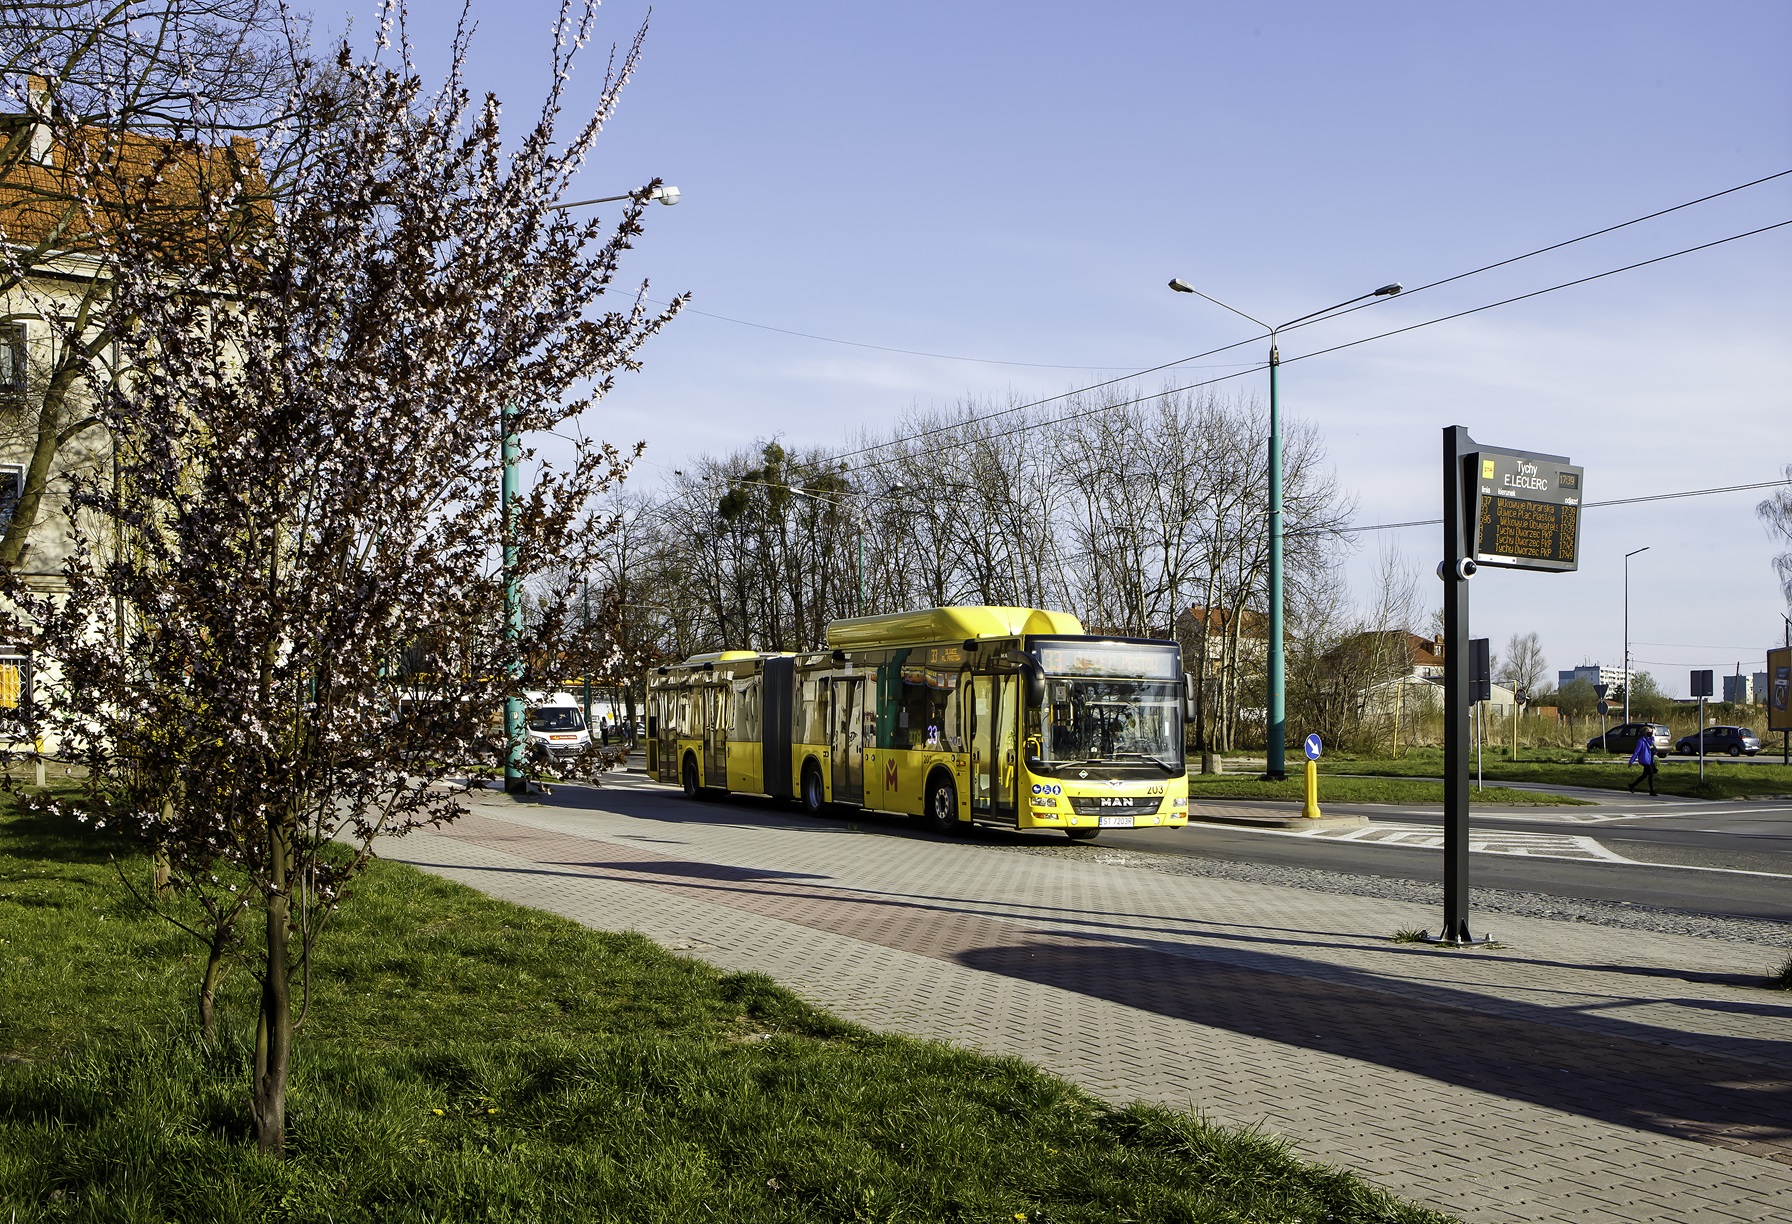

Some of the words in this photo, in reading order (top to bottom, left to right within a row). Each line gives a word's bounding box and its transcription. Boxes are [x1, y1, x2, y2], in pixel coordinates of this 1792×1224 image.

[1517, 461, 1538, 477] Tychy
[1504, 474, 1548, 491] E.LECLERC
[1518, 510, 1531, 519] Plac
[1496, 524, 1515, 535] Tychy
[1515, 527, 1541, 538] Dworzec
[1541, 530, 1553, 540] PKP
[1495, 533, 1514, 544] Tychy
[1514, 536, 1540, 547] Dworzec
[1541, 539, 1553, 549] PKP
[1495, 542, 1514, 553] Tychy
[1514, 545, 1540, 556] Dworzec
[1540, 547, 1552, 558] PKP
[930, 648, 938, 663] 33
[1043, 649, 1063, 671] 33
[928, 725, 938, 745] 33
[1146, 785, 1164, 795] 203
[1100, 797, 1134, 807] MAN
[1103, 817, 1111, 825] ST
[1113, 817, 1132, 825] 7203R
